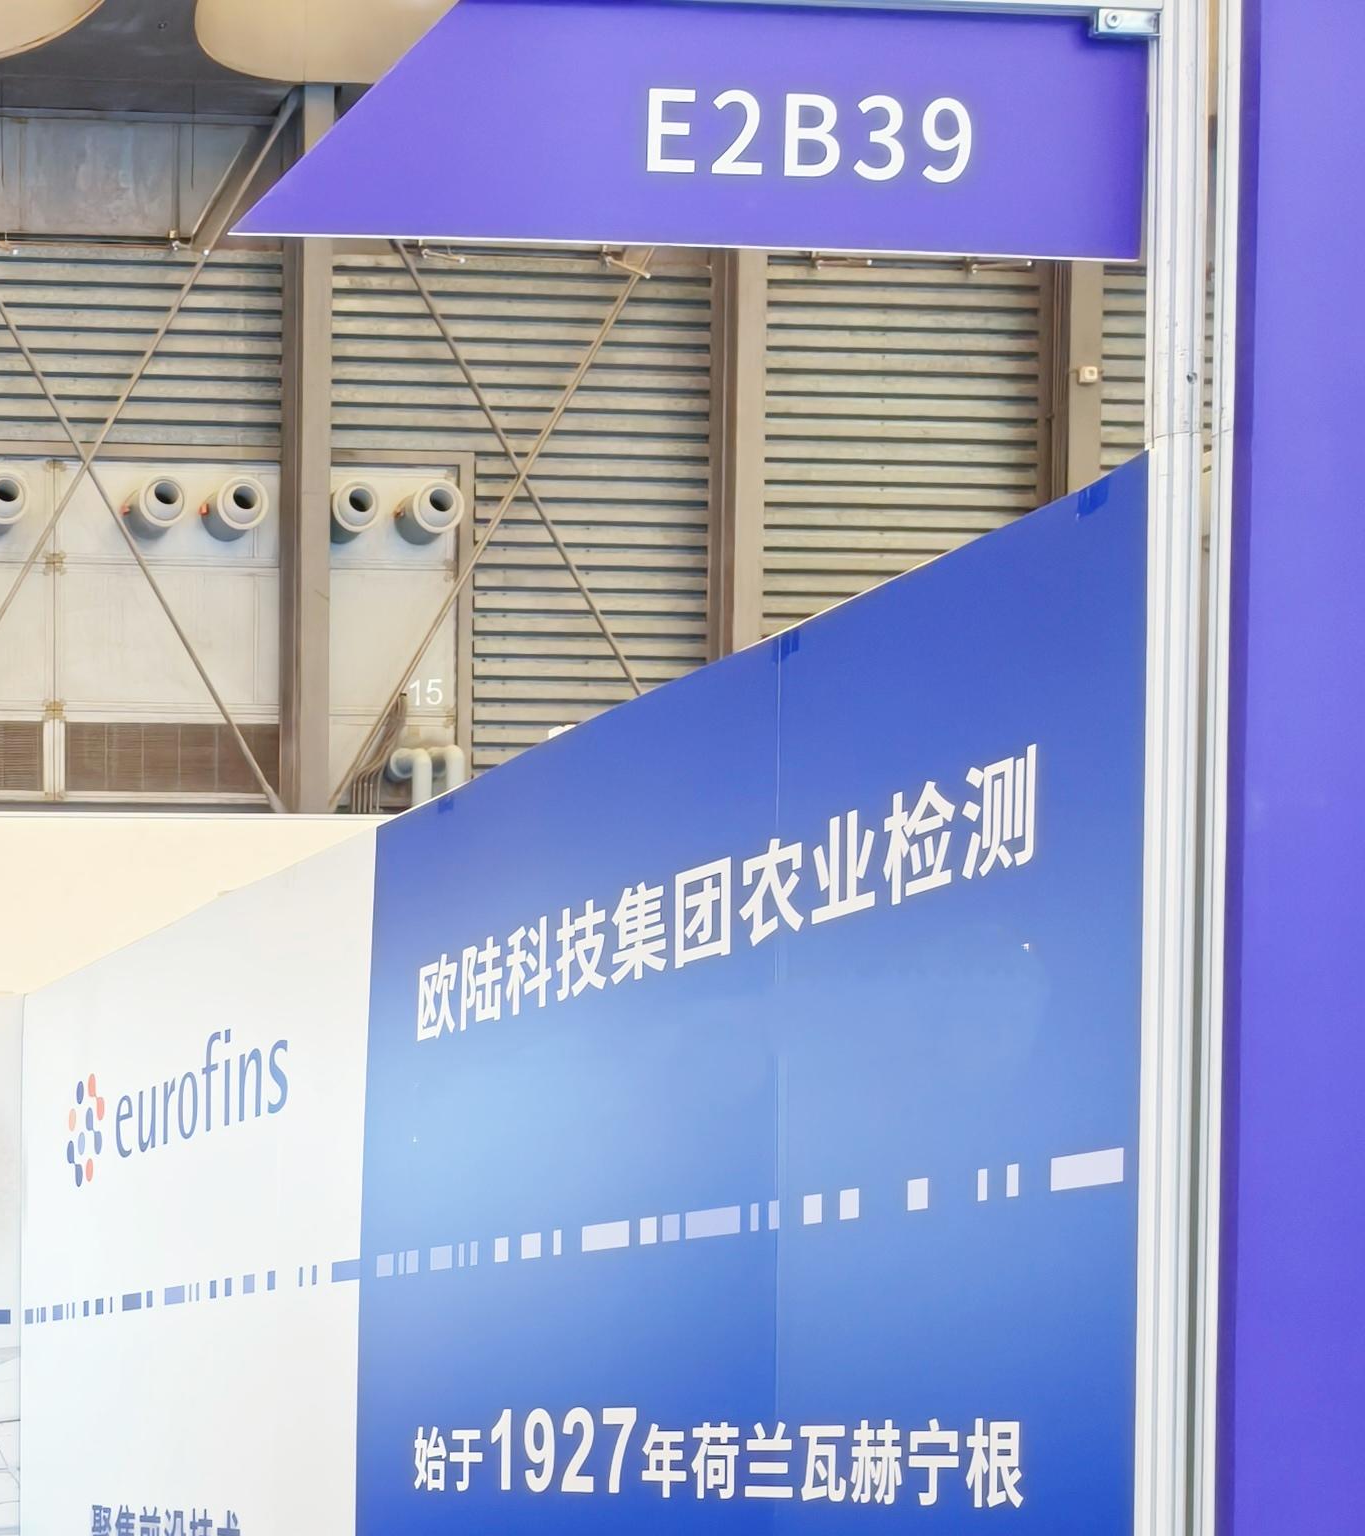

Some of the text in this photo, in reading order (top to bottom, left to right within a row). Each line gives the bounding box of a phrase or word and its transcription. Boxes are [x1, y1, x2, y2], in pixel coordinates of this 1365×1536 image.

[646, 87, 973, 184] E2B39
[409, 678, 444, 707] 15
[416, 744, 1038, 1042] 欧陆科技集团农业检测
[114, 1028, 289, 1160] eurofins
[414, 1406, 1025, 1509] 始于1927年荷兰瓦赫宁根
